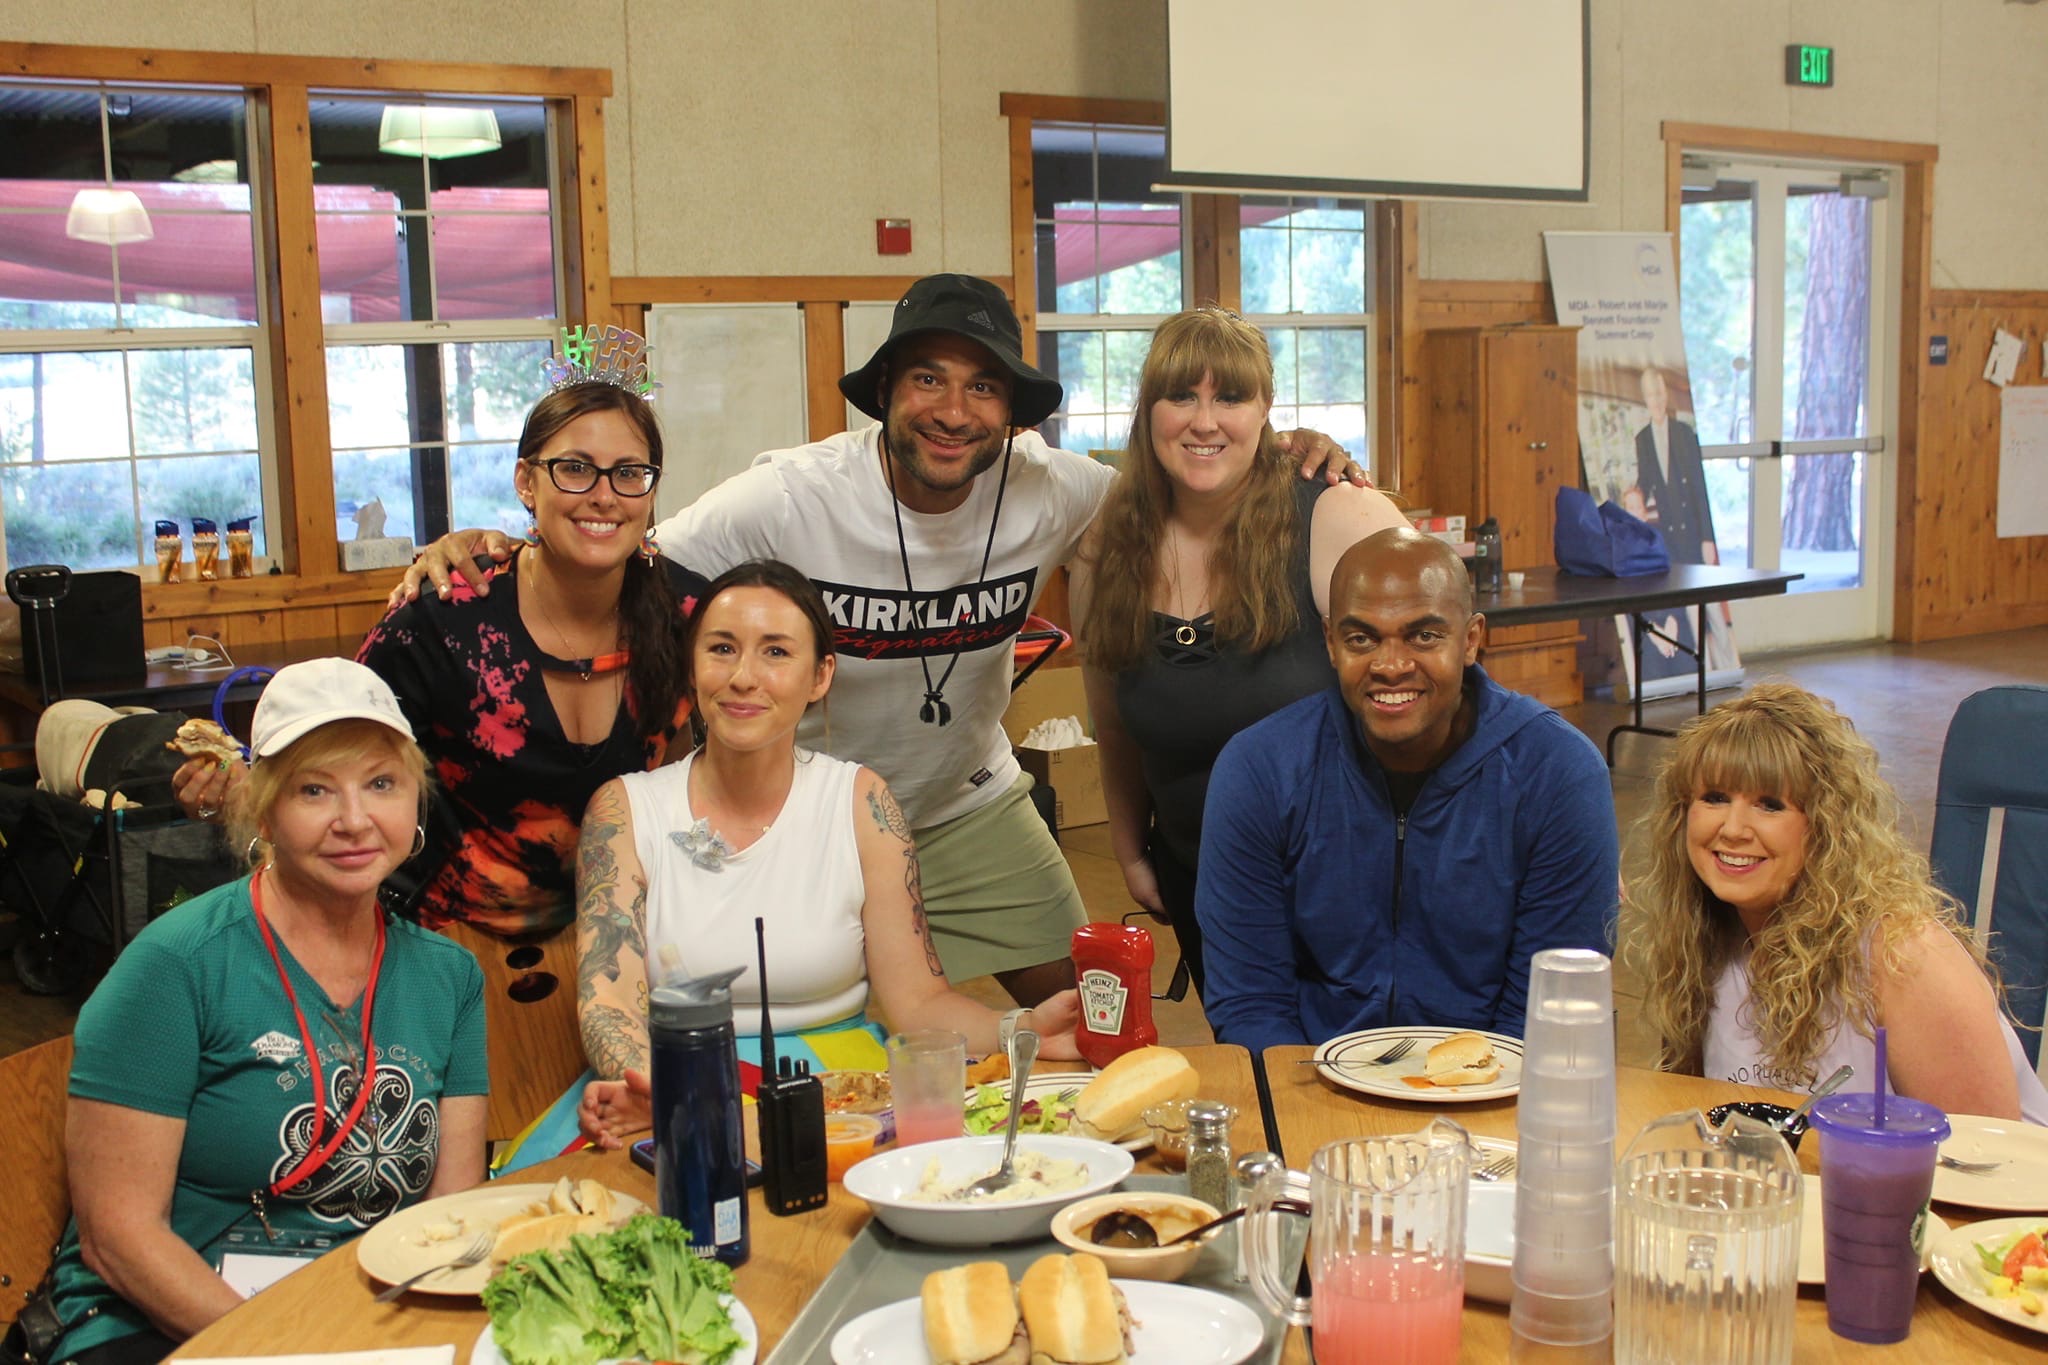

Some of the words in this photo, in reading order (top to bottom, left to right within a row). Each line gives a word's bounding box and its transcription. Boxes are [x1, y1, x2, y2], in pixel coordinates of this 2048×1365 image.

[1800, 46, 1829, 83] EXIT
[1598, 299, 1625, 310] Robert
[822, 581, 1027, 632] KIRKLAND
[832, 624, 1012, 661] Signature
[1090, 978, 1112, 988] HEINZ
[1089, 990, 1116, 1001] TOMATO
[1727, 1066, 1750, 1084] NO
